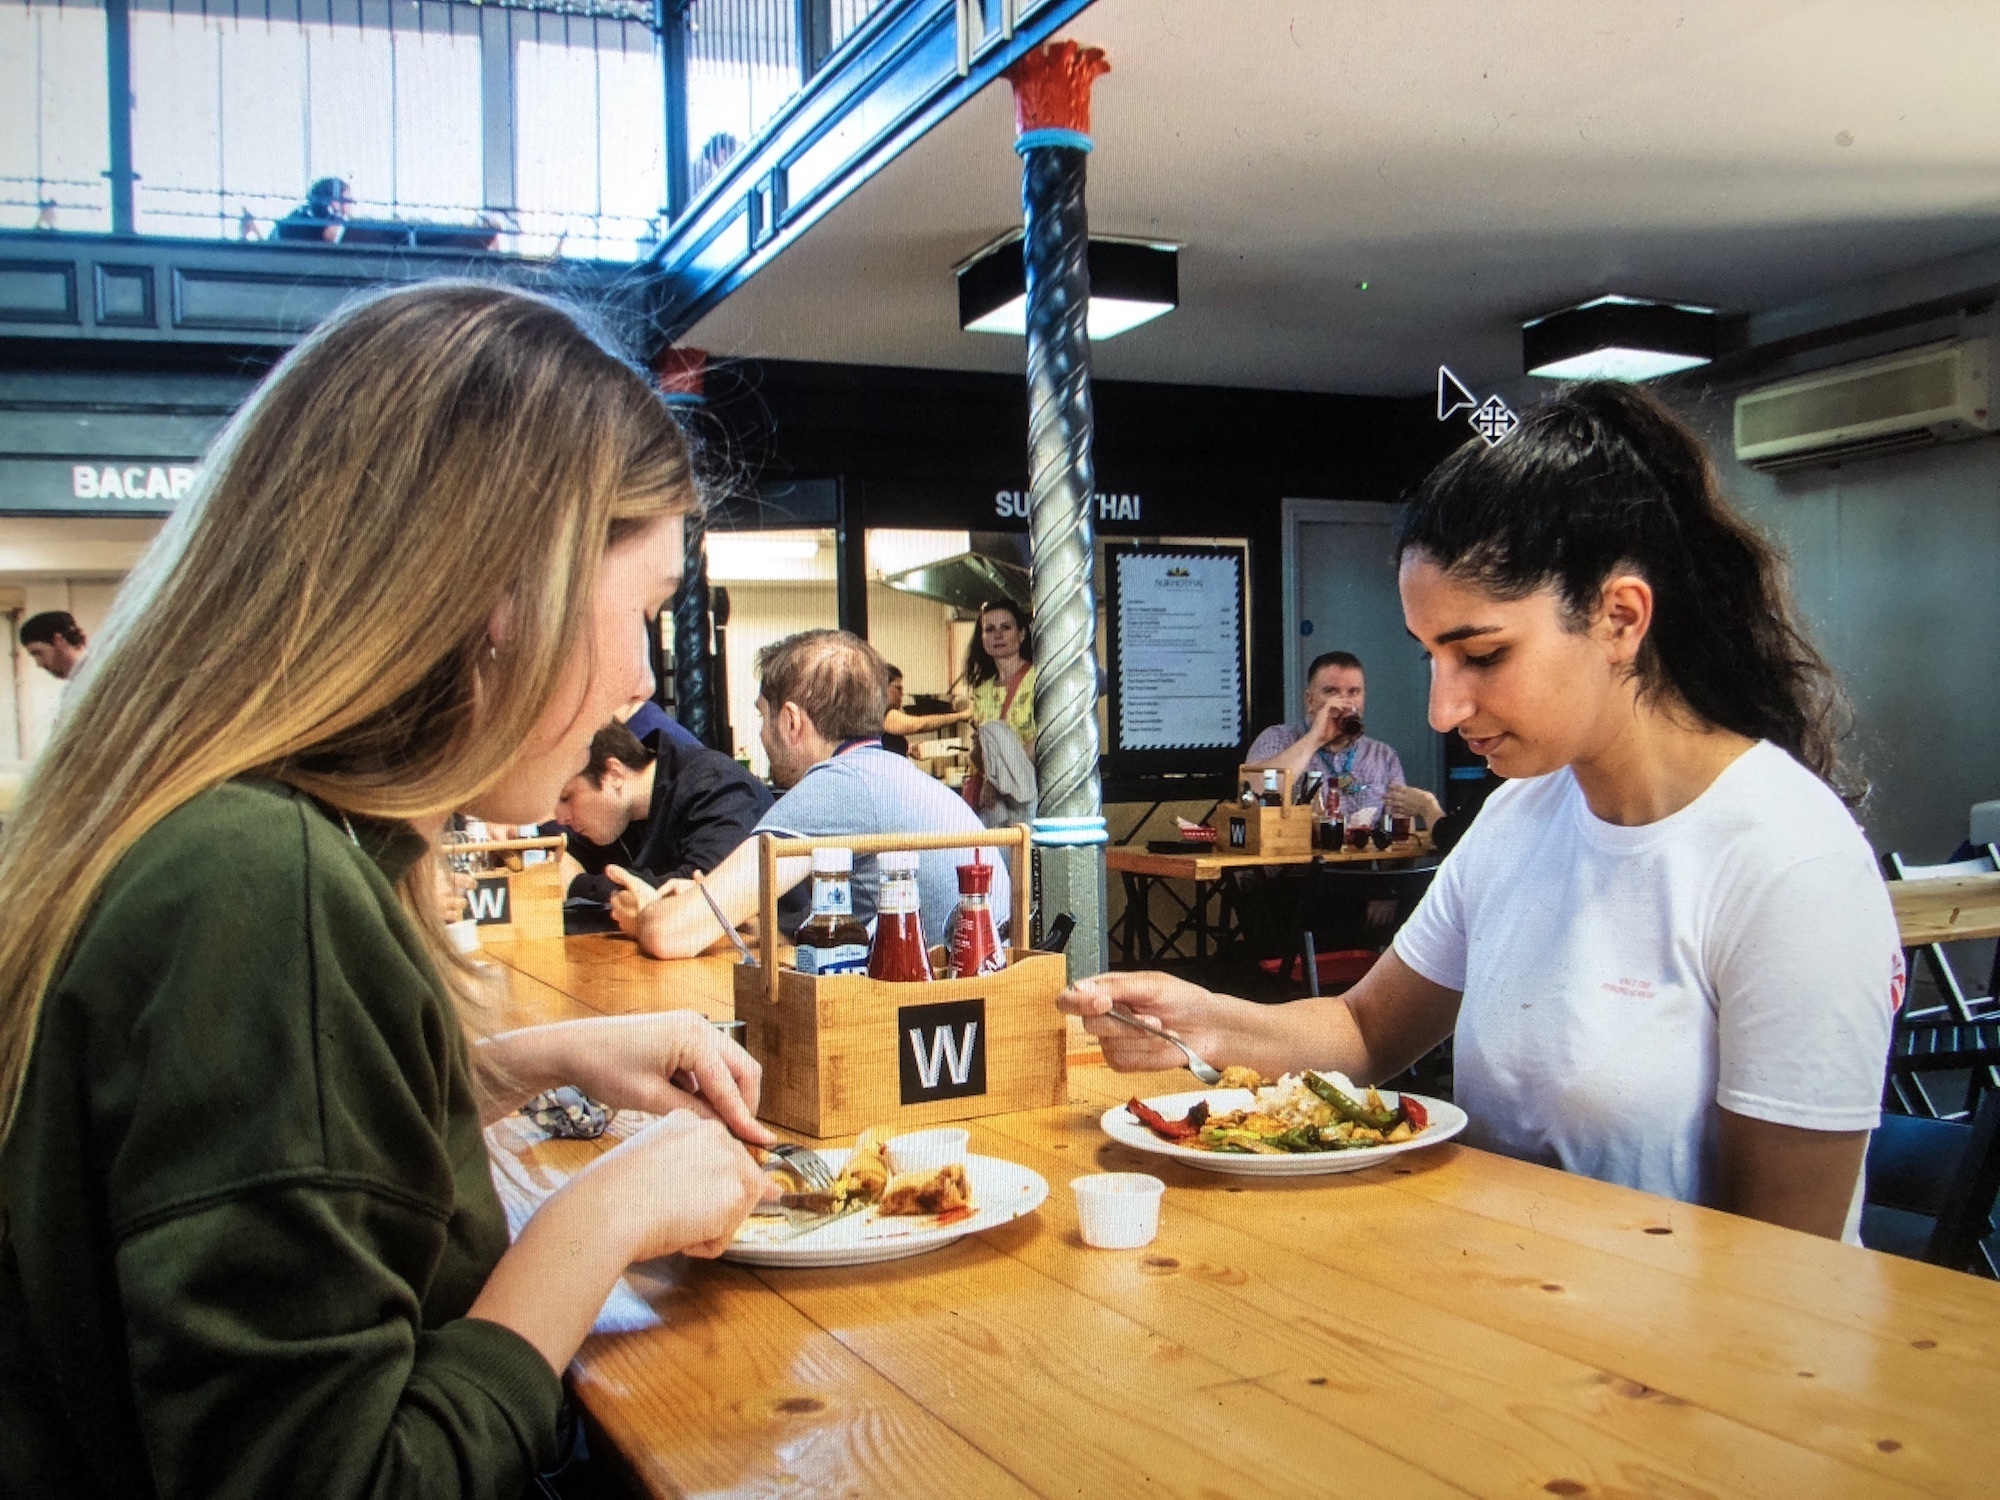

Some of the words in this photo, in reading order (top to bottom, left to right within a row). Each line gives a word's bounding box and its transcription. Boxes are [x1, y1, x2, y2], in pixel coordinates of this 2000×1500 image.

[72, 465, 199, 499] BACAR
[1231, 824, 1245, 845] W
[466, 887, 506, 919] W
[908, 1020, 978, 1089] W
